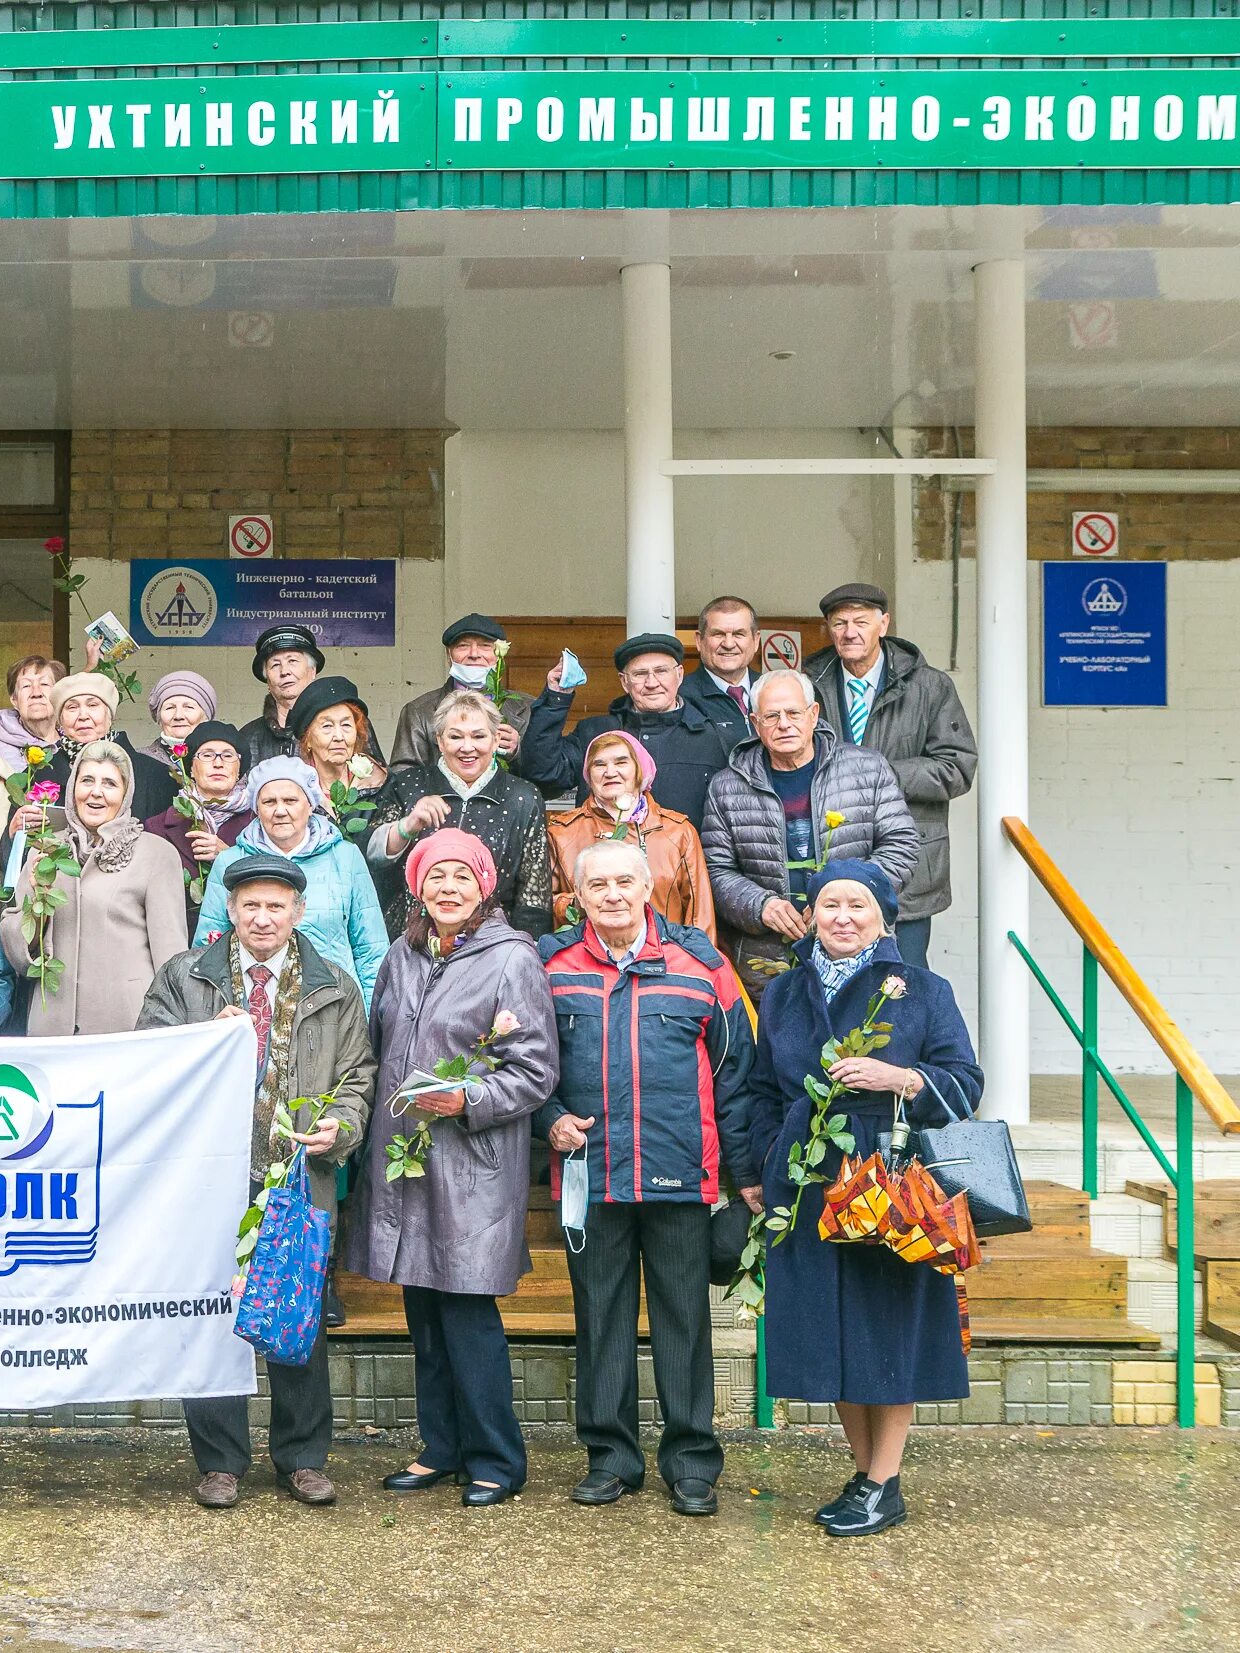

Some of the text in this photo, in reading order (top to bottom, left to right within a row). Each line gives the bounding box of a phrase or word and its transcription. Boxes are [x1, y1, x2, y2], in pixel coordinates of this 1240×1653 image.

[51, 89, 1239, 150] УХТИНСКИЙ ПРОМЫШЛЕННО-ЭКОНОМ
[235, 573, 305, 586] Инженерно
[315, 573, 378, 585] кадетский
[278, 588, 334, 600] батальон
[226, 607, 387, 621] Индустриальный институт
